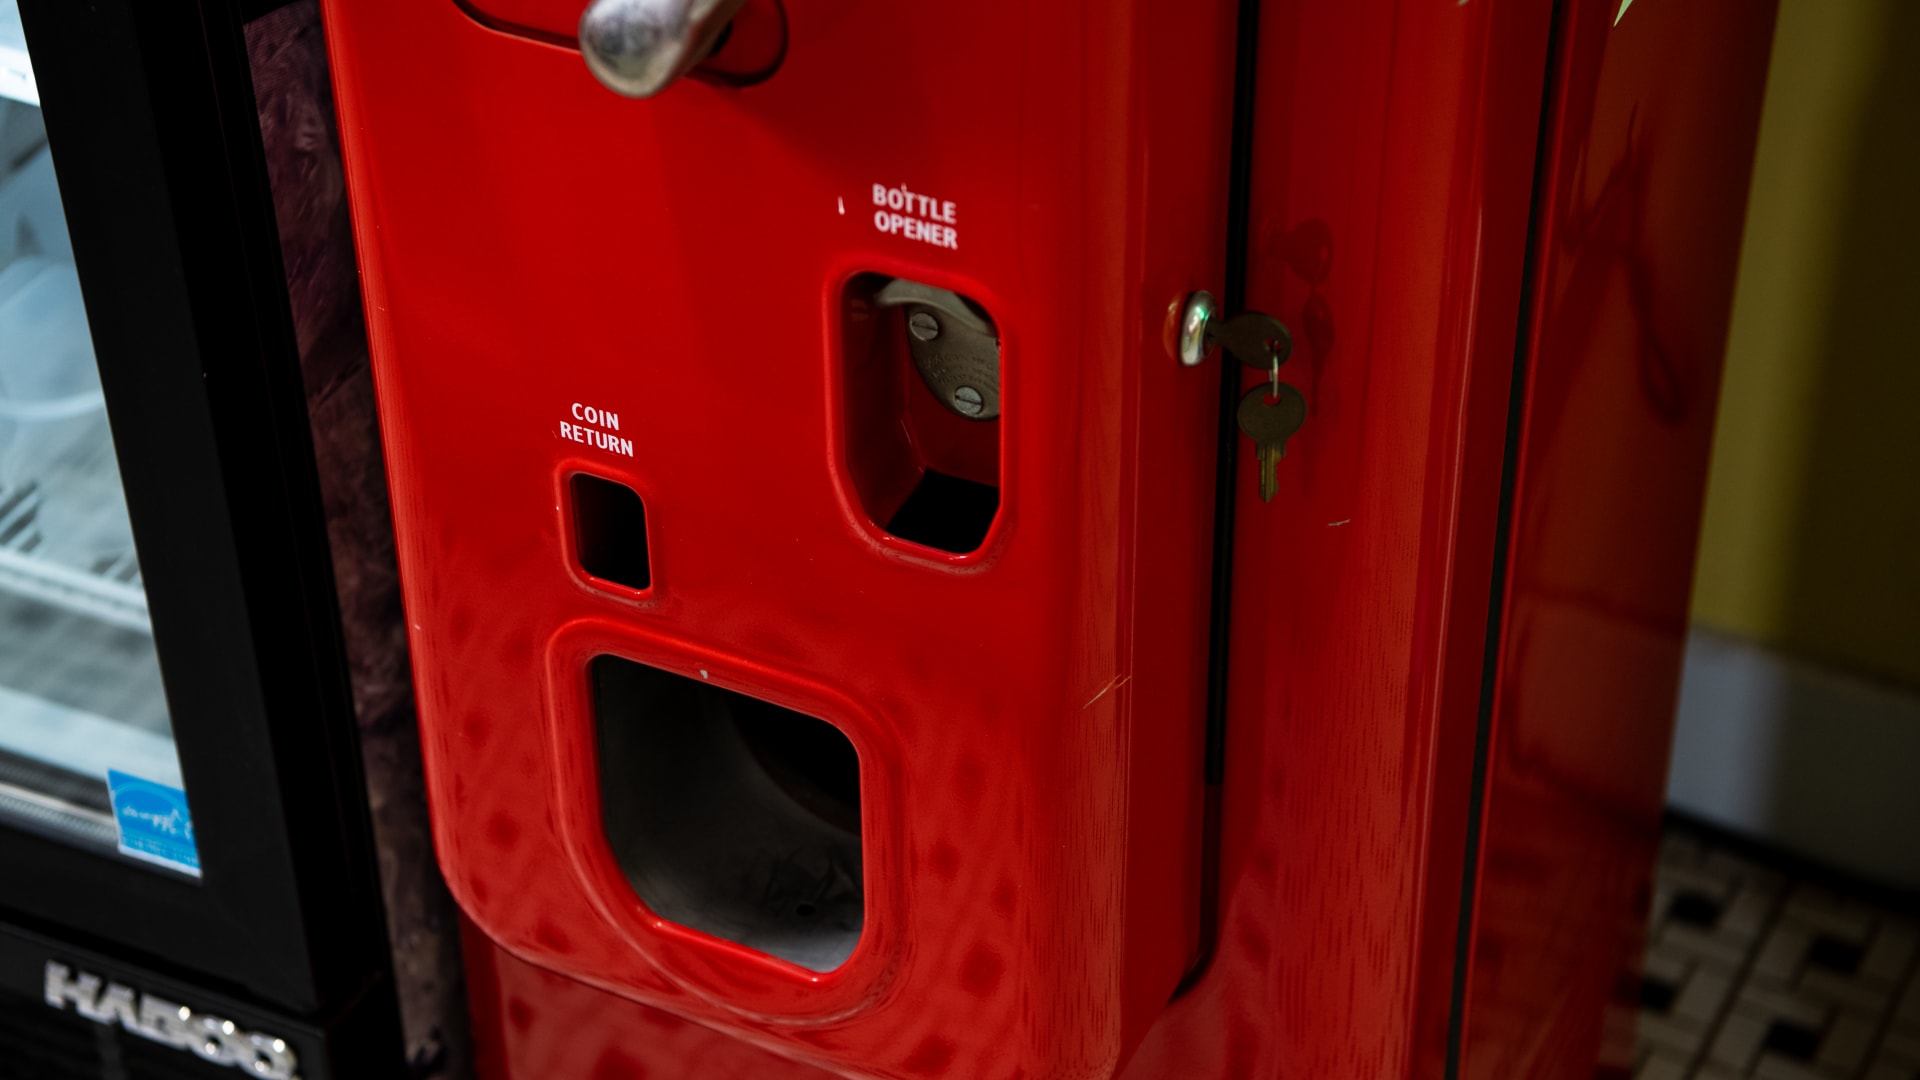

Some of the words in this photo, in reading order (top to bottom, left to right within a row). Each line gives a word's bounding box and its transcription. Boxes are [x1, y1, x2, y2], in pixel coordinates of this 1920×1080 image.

[872, 183, 957, 224] BOTTLE
[874, 210, 958, 250] OPENER
[571, 402, 619, 430] COIN
[559, 420, 633, 457] RETURN
